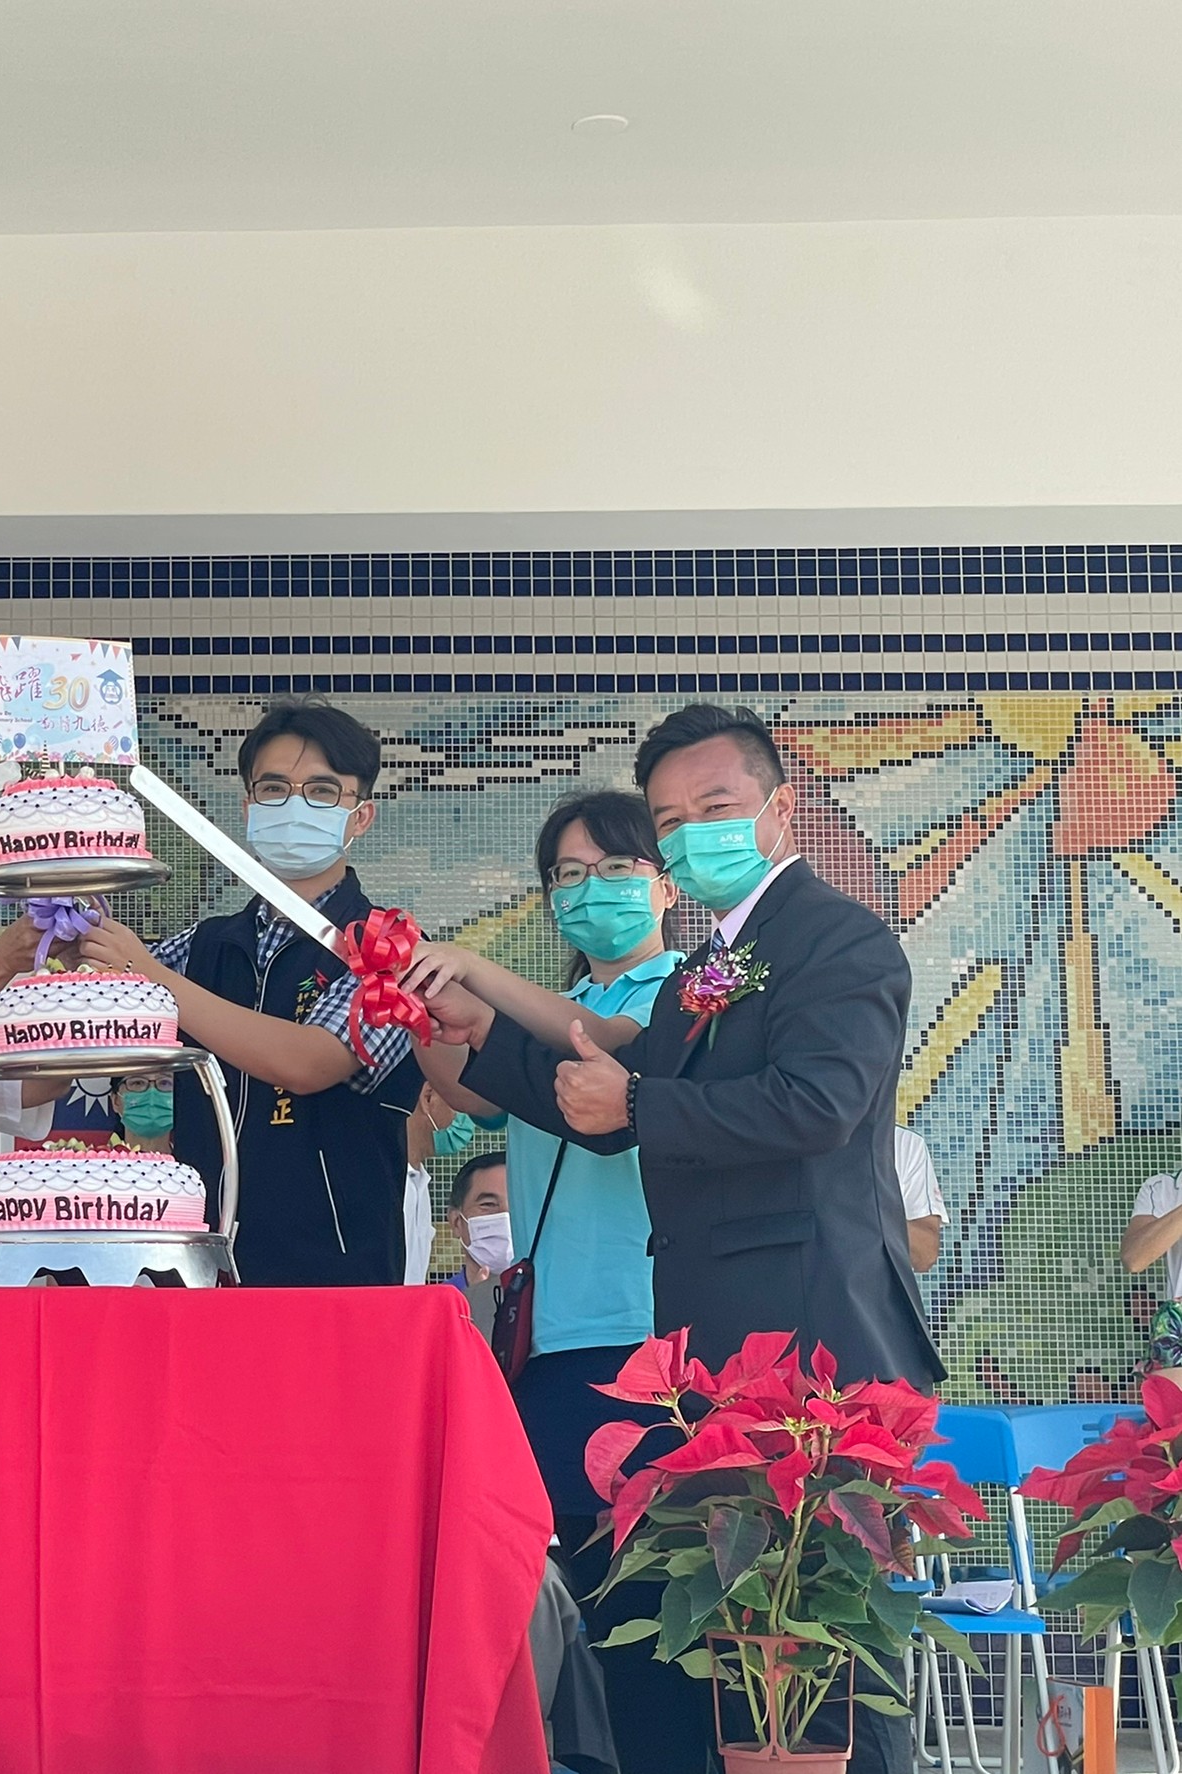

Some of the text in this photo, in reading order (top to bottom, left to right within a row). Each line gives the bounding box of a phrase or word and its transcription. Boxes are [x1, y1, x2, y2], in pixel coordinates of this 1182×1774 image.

[0, 830, 140, 854] Happy Birthday
[4, 1018, 161, 1045] Happy Birthday
[54, 1194, 169, 1222] Birthday
